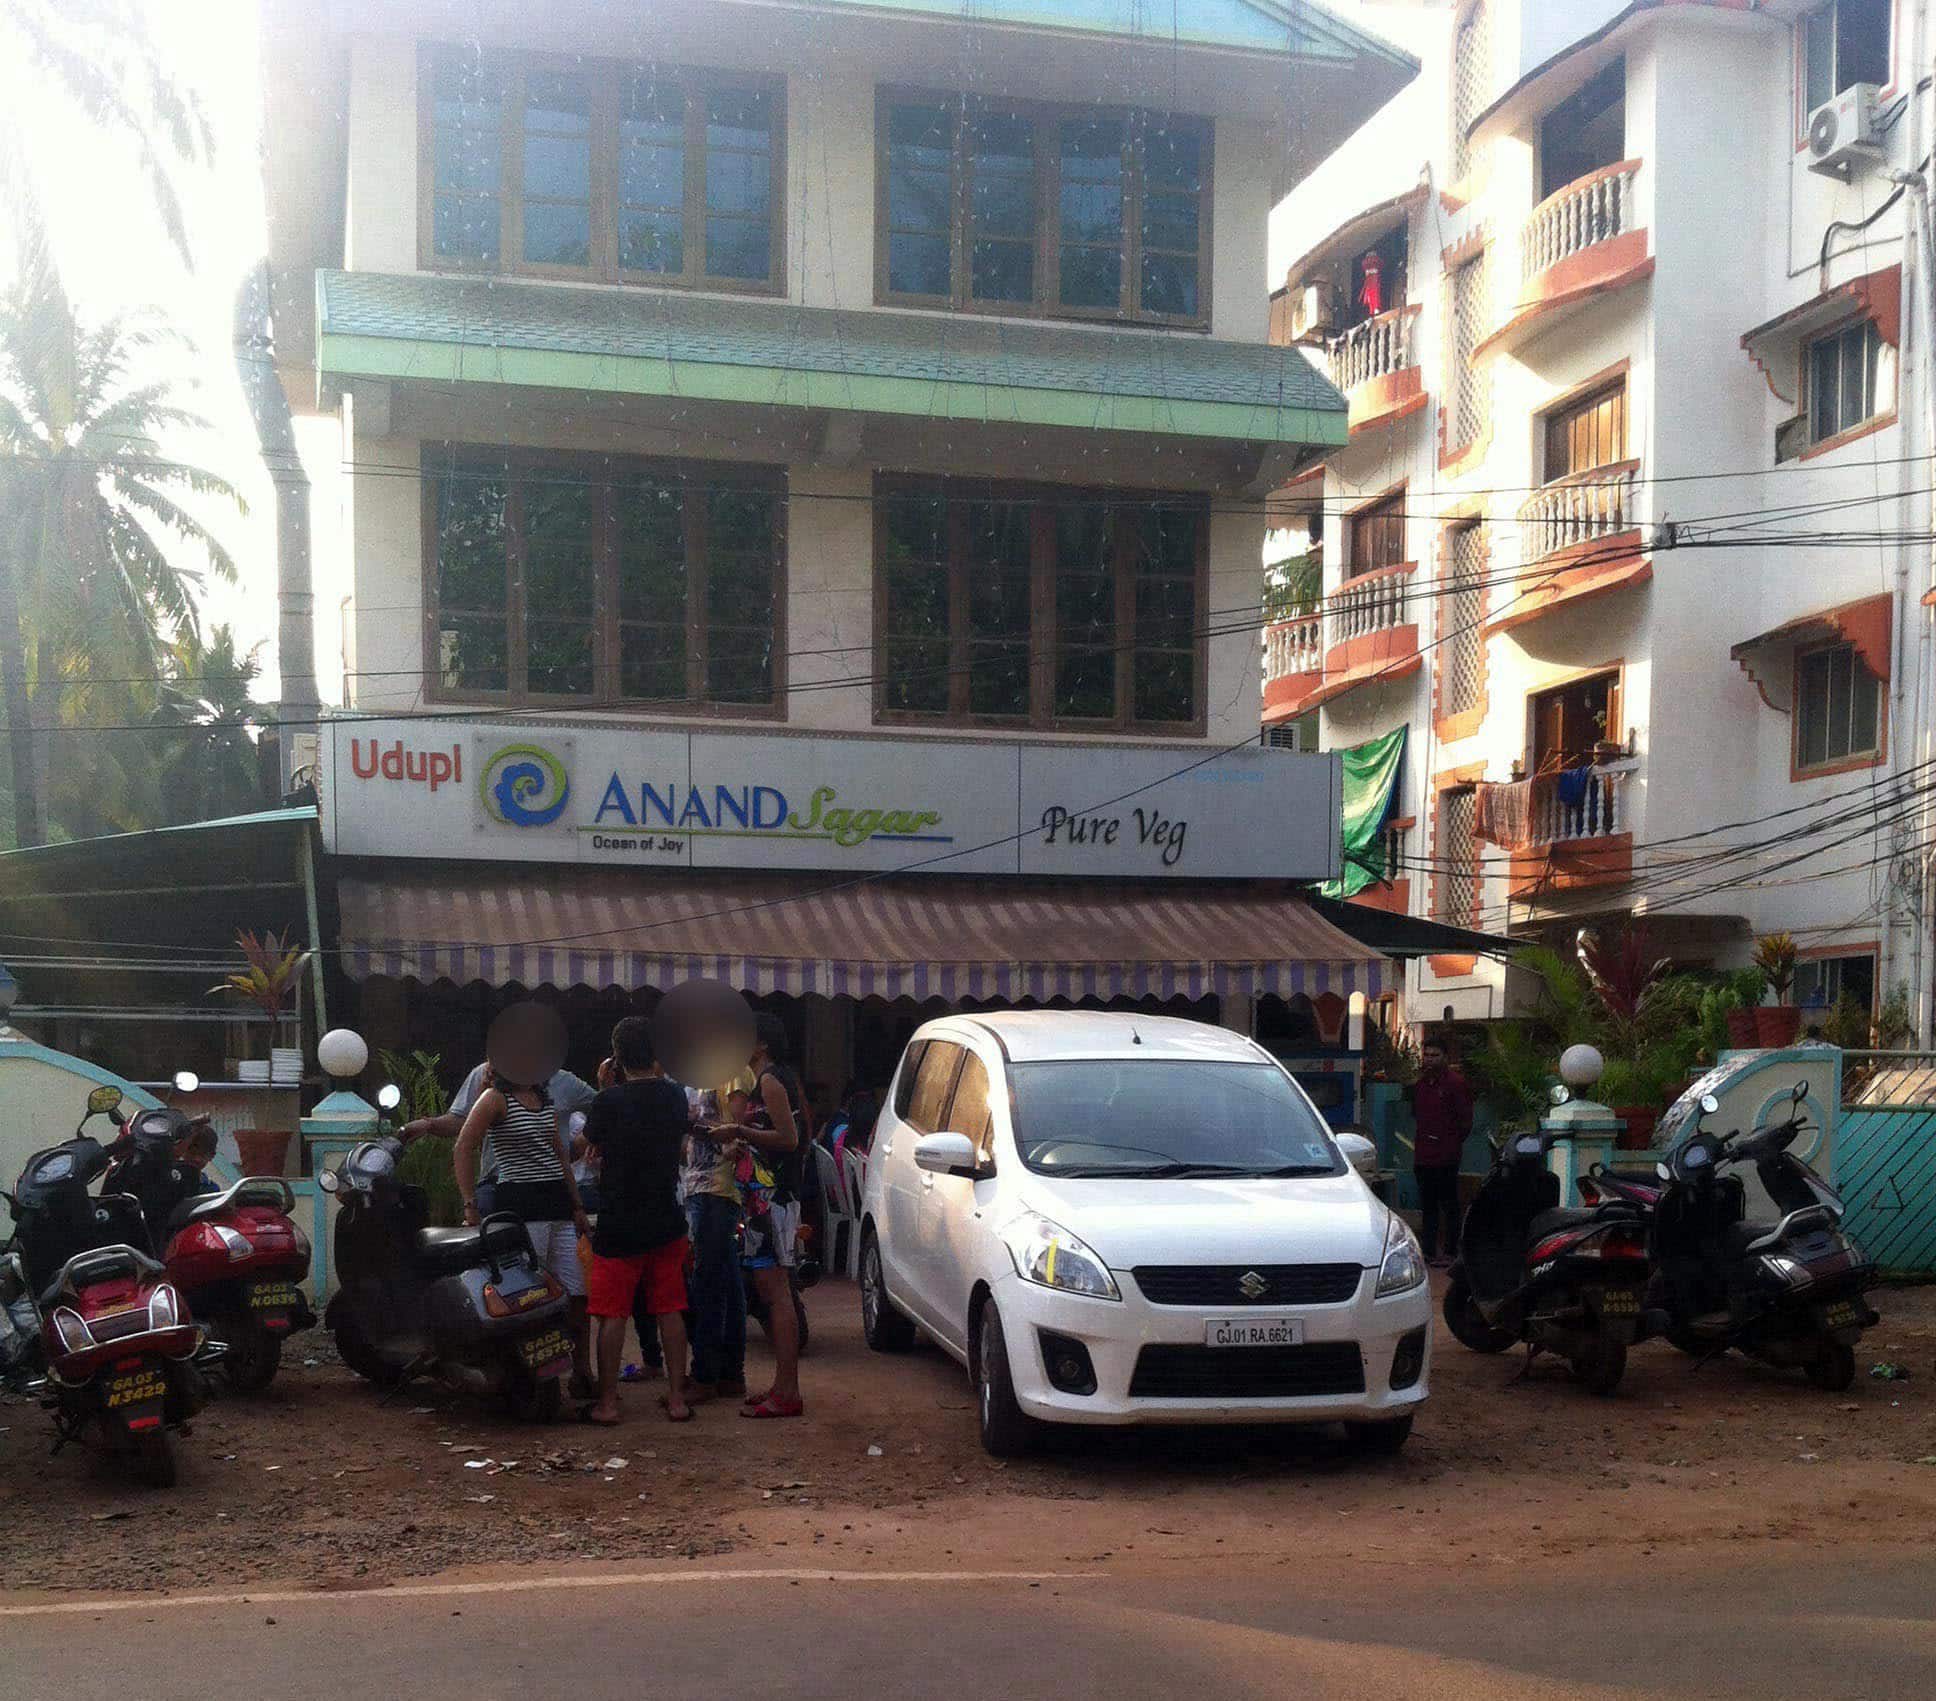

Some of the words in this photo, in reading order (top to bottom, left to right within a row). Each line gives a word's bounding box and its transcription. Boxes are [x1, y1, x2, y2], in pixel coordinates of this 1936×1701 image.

[595, 771, 788, 828] ANAND
[788, 786, 942, 847] Sagar
[1042, 806, 1120, 844] Pure
[1133, 808, 1187, 865] Veg
[593, 835, 637, 849] Ocean
[640, 836, 654, 850] of
[658, 837, 684, 854] Joy
